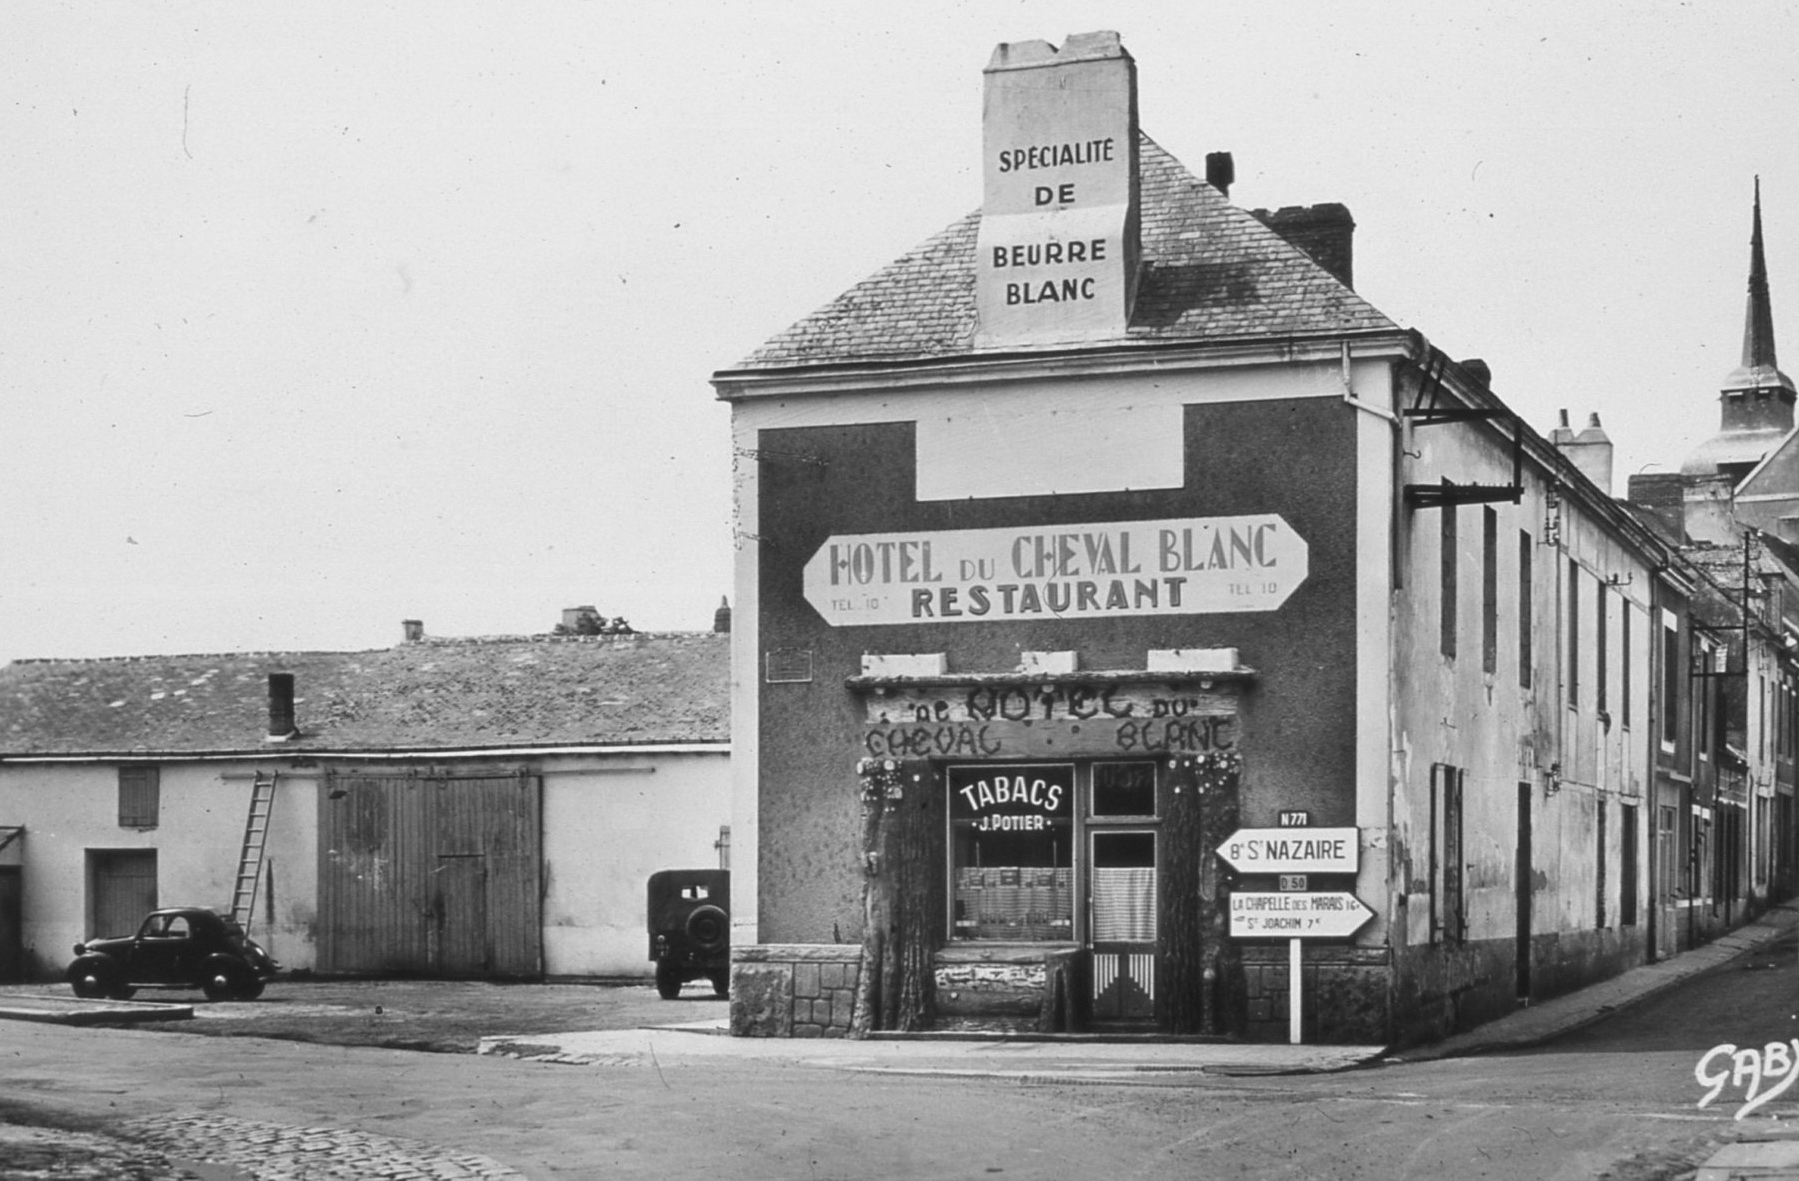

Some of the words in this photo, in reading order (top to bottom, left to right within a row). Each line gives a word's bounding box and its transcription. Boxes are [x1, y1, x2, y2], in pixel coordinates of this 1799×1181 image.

[999, 138, 1114, 172] SPÉCIALITÉ
[1035, 183, 1075, 206] DE
[993, 239, 1106, 268] BEURRE
[1006, 278, 1095, 305] BLANC
[830, 540, 942, 586] HOTEL
[959, 558, 995, 582] DU
[1011, 532, 1141, 579] CHEVAL
[1159, 523, 1277, 572] BLANC
[911, 576, 1187, 618] RESTAURANT
[865, 724, 1001, 757] CHEVAL
[1116, 719, 1234, 750] BLANC
[959, 776, 1063, 811] TABACS
[1266, 840, 1346, 860] NAZAIRE
[1232, 899, 1243, 911] LA
[1245, 897, 1291, 911] CHAPELLE
[1292, 900, 1307, 911] DES
[1311, 896, 1344, 911] MARAIS
[1262, 918, 1302, 929] JOACHIM
